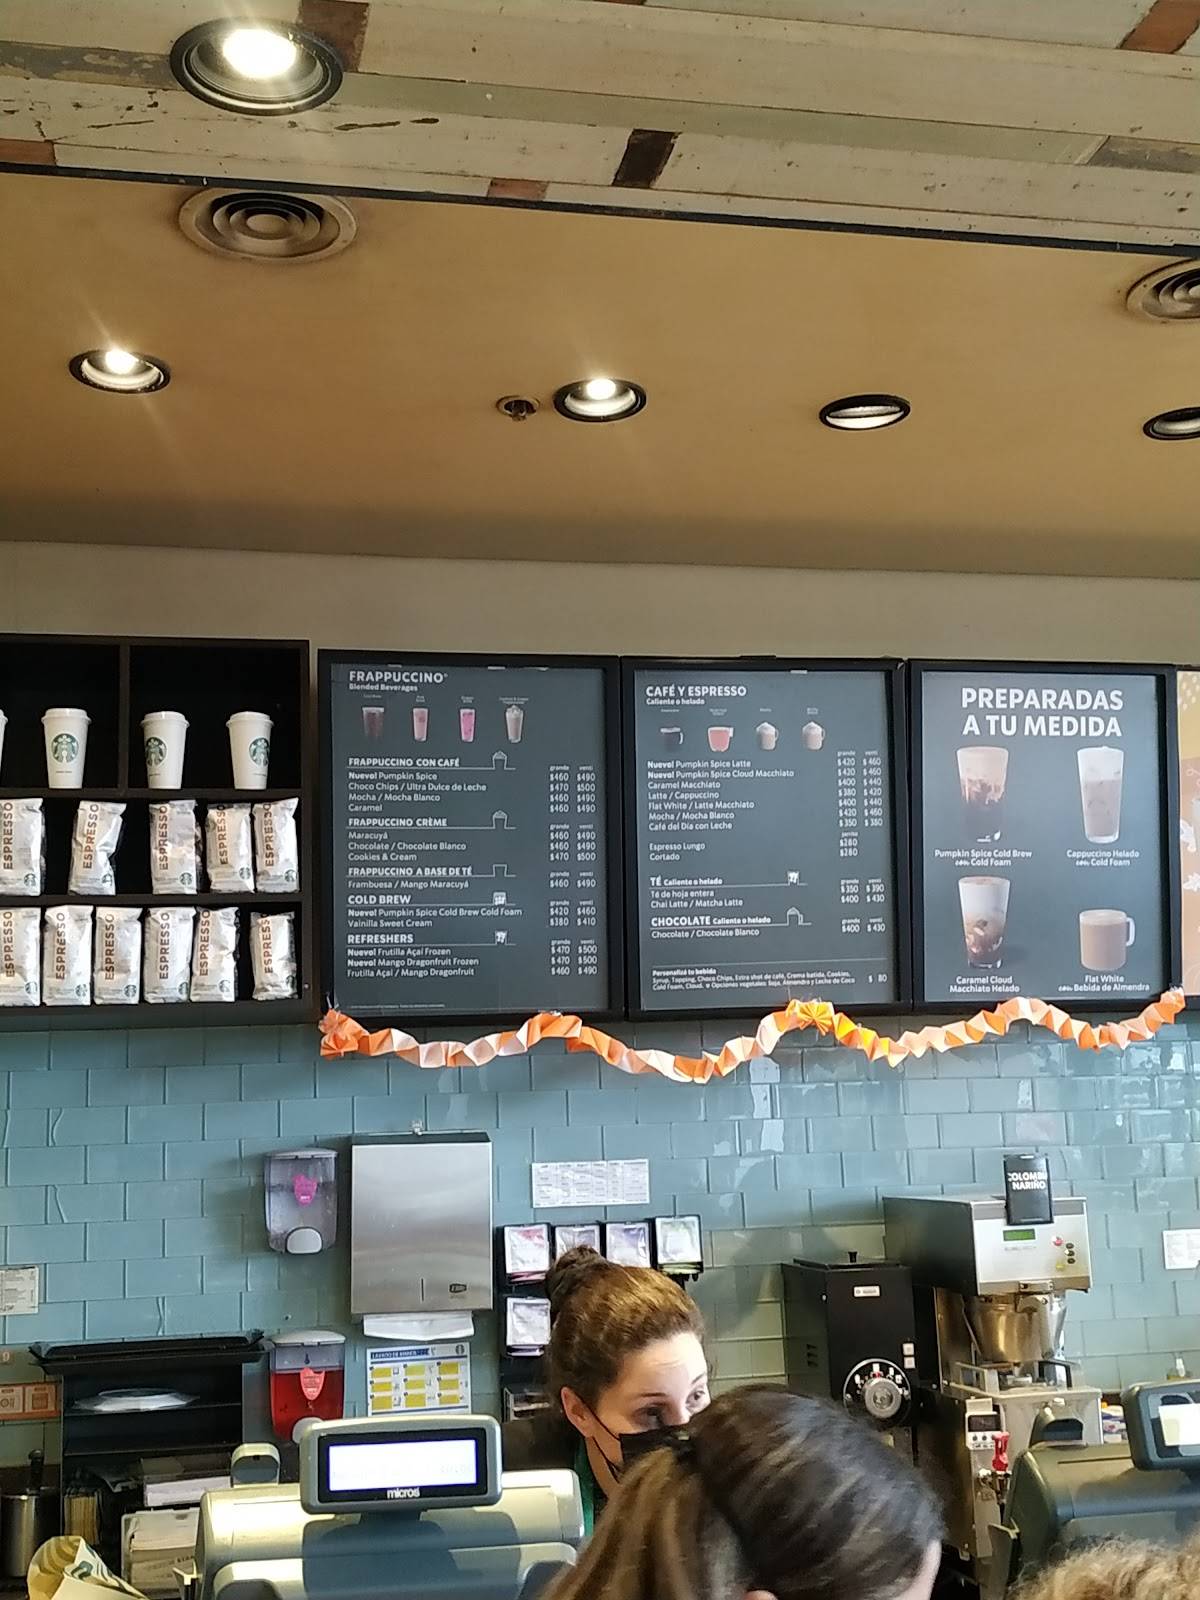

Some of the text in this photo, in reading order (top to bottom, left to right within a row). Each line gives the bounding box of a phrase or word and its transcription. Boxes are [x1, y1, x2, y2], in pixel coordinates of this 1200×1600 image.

[646, 684, 746, 696] CAFÉ Y ESPRESSO
[962, 687, 1123, 710] PREPARADAS
[963, 715, 1122, 737] A TU MEDIDA
[348, 758, 459, 766] FRAPPUCCINO CON CAFÉ
[378, 772, 414, 780] Pumpkin
[416, 772, 437, 780] Spice
[376, 783, 398, 791] Chips
[3, 802, 13, 870] ESPRESSO
[83, 804, 99, 869] ESPRESSO
[159, 805, 168, 870] ESPRESSO
[348, 832, 388, 840] Maracuyá
[650, 842, 705, 851] Espresso Lungo
[935, 850, 969, 859] Pumpkin
[971, 850, 992, 859] Spice
[1067, 850, 1110, 859] Cappuccino
[425, 868, 447, 876] BASE
[449, 868, 459, 876] DE
[461, 866, 472, 875] TÉ
[401, 881, 468, 890] Mango Maracuyá
[650, 875, 661, 886] TÉ
[672, 890, 688, 898] hoja
[348, 895, 411, 904] COLD BREW
[378, 909, 414, 918] Pumpkin
[416, 908, 437, 917] Spice
[652, 916, 710, 926] CHOCOLATE
[200, 910, 210, 976] ESPRESSO
[348, 934, 413, 943] REFRESHERS
[3, 911, 15, 977] ESPRESSO
[56, 912, 65, 980] ESPRESSO
[105, 914, 114, 980] ESPRESSO
[160, 912, 170, 979] ESPRESSO
[956, 976, 1012, 984] Caramel Cloud
[950, 984, 1020, 993] Macchiato Helado
[387, 1487, 420, 1498] micros
